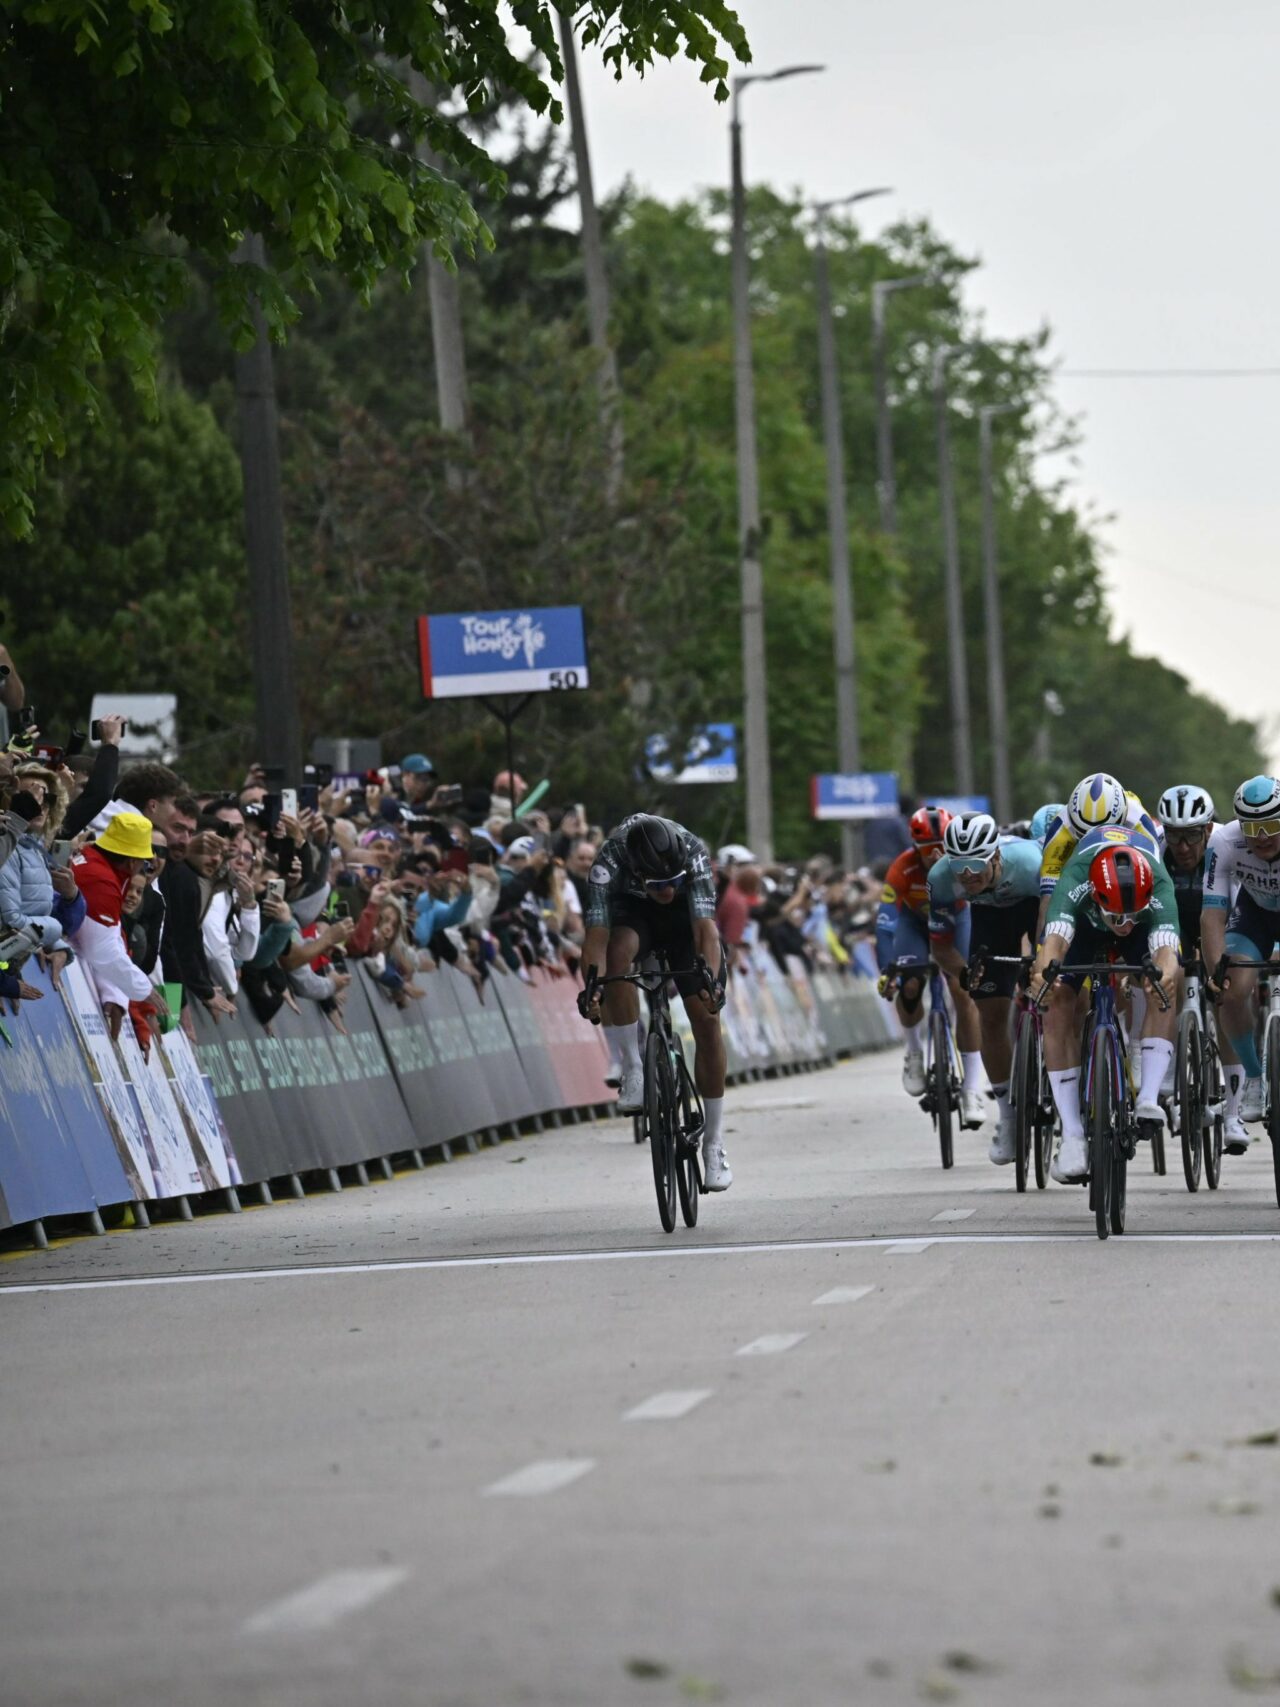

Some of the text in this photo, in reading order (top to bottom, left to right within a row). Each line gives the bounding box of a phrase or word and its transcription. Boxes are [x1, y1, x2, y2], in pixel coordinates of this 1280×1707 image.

[460, 616, 511, 636] Tour
[549, 670, 579, 691] 50
[1101, 857, 1113, 890] TREK
